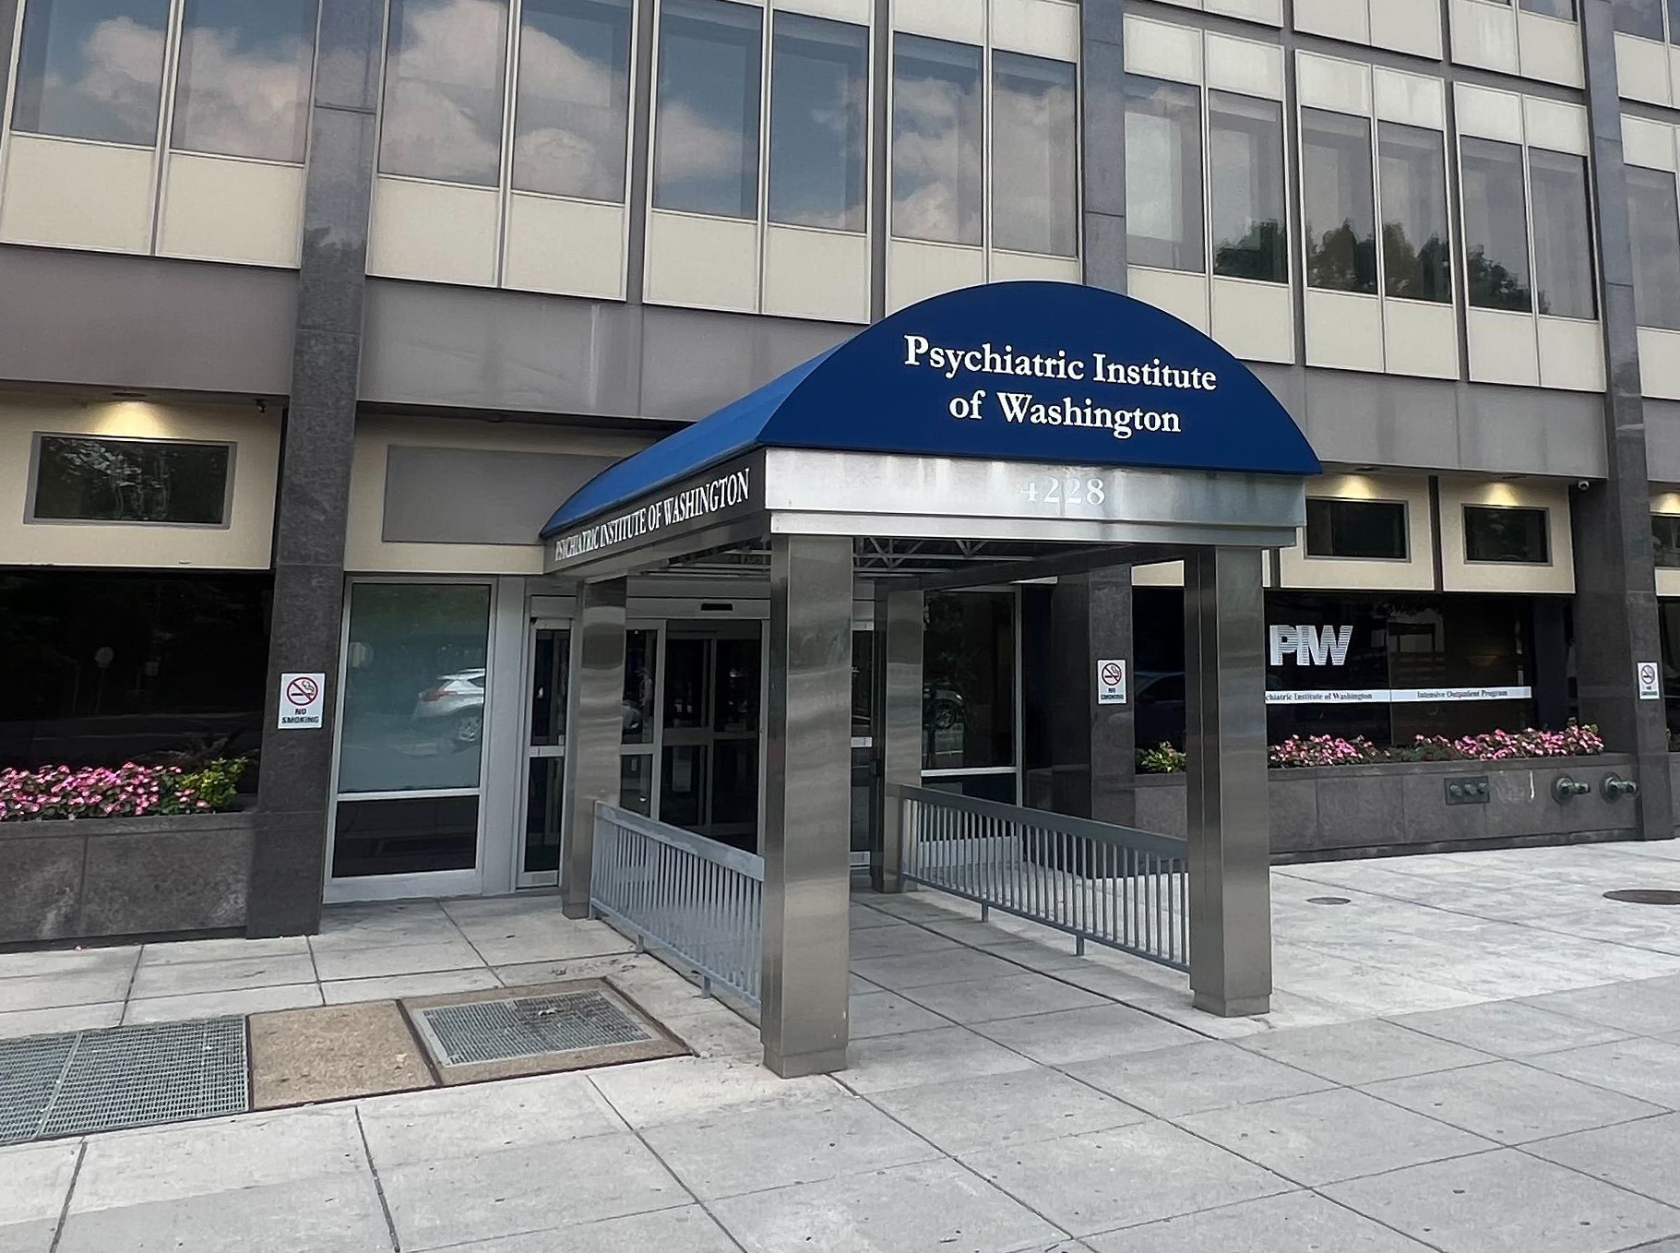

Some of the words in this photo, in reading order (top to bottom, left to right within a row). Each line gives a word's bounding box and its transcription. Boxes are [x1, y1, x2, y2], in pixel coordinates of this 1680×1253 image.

[904, 335, 1084, 379] Psychiatric
[1093, 352, 1217, 390] Institute
[949, 390, 986, 419] of
[997, 391, 1181, 439] Washington
[554, 526, 600, 562] PSYCHIATRIC
[600, 508, 646, 547] INSTITUTE
[648, 501, 663, 532] OF
[664, 468, 751, 526] WASHINGTON
[1269, 625, 1353, 665] PIW
[1324, 692, 1331, 700] of
[1333, 692, 1372, 700] Washington
